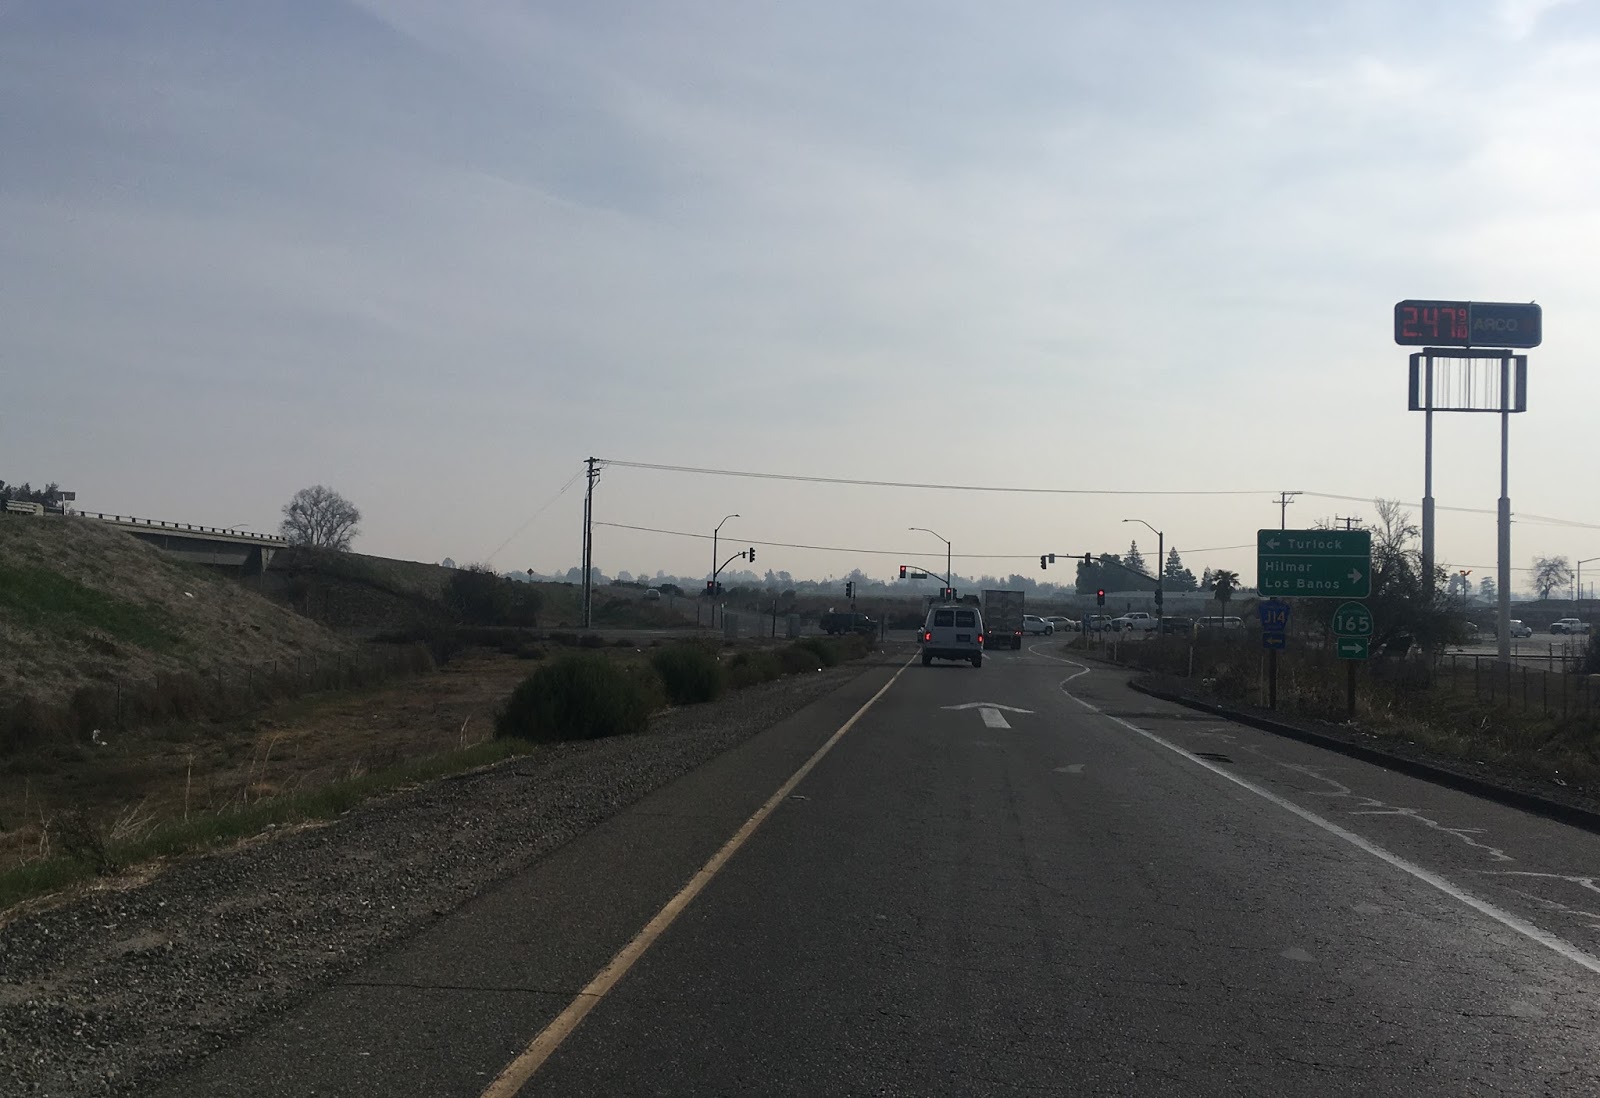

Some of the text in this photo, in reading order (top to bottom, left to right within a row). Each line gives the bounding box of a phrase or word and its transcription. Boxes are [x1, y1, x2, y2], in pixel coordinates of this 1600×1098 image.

[1474, 318, 1518, 331] ARCO
[1288, 539, 1342, 549] Turlock
[1265, 561, 1312, 572] Hilmar
[1265, 578, 1340, 589] Los Banos
[1264, 610, 1286, 624] J14
[1337, 615, 1369, 631] 165
